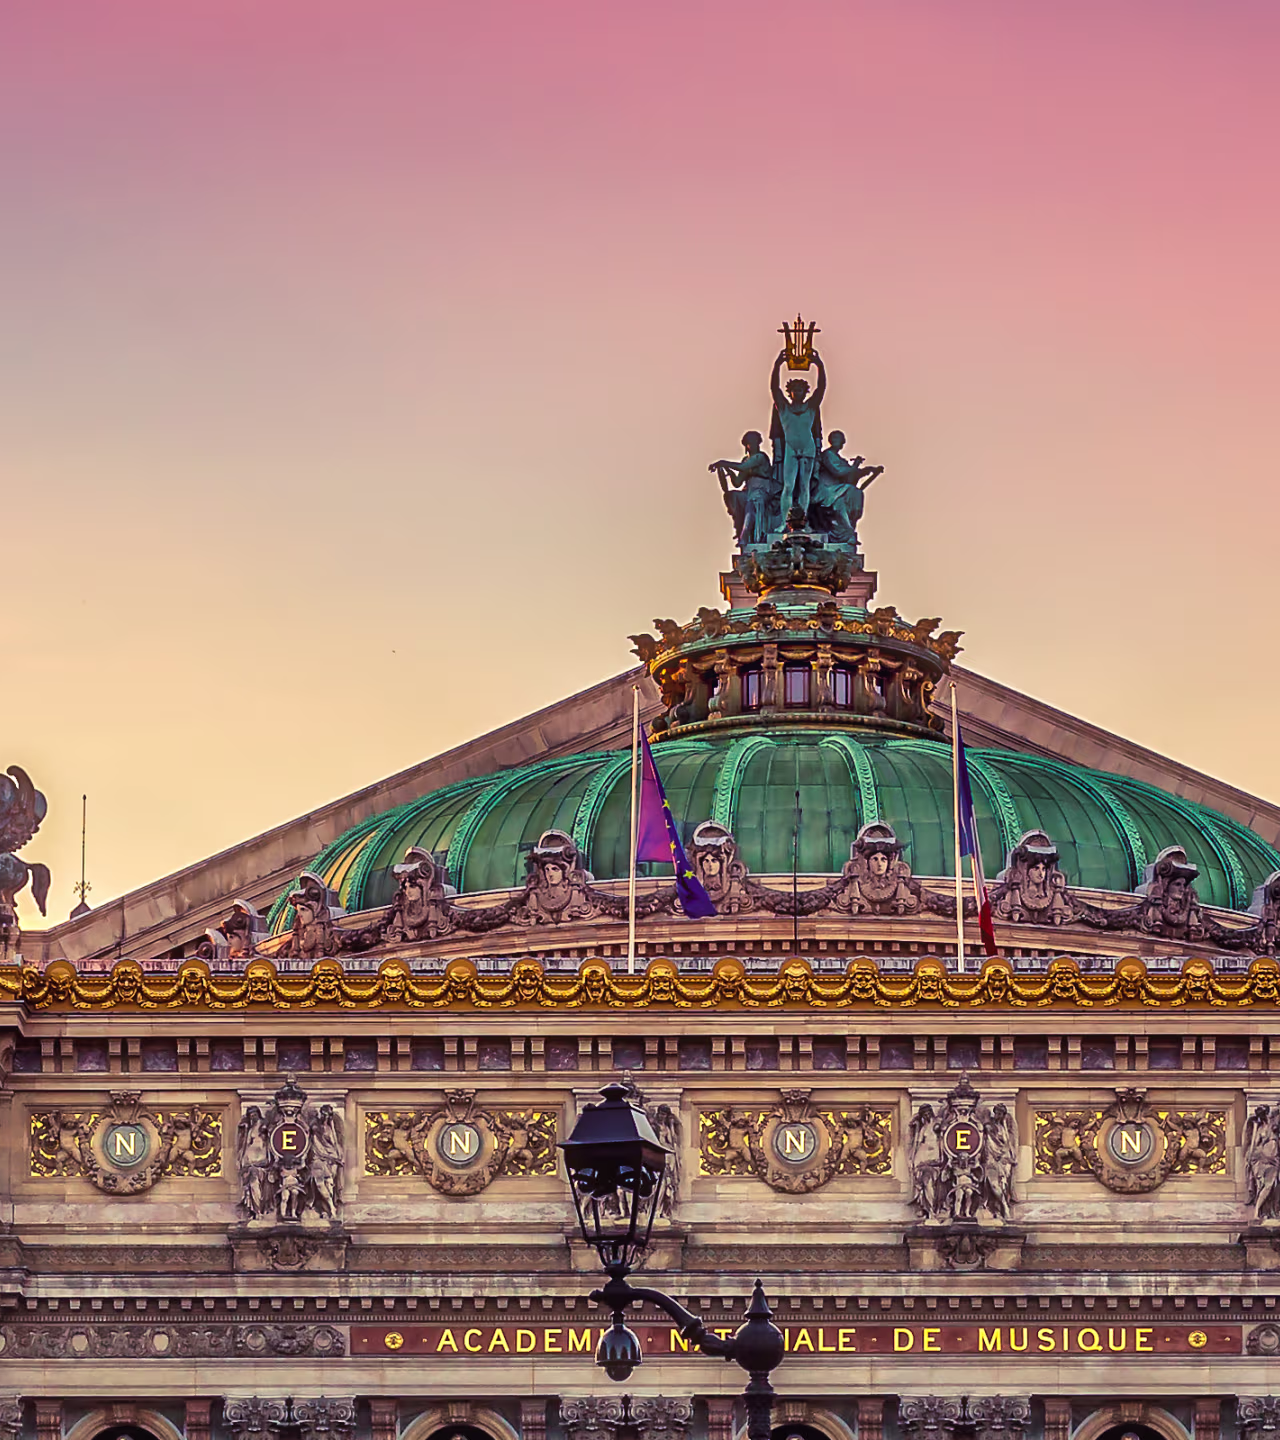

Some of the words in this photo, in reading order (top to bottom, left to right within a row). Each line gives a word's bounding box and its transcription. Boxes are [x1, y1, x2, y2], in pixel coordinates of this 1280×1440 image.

[115, 1132, 136, 1156] N
[282, 1130, 297, 1150] E
[450, 1131, 471, 1155] N
[785, 1130, 806, 1154] N
[955, 1129, 971, 1150] E
[1121, 1130, 1142, 1154] N
[436, 1328, 605, 1352] ACADEM
[893, 1328, 941, 1352] DE
[978, 1328, 1154, 1352] MUSIQUE
